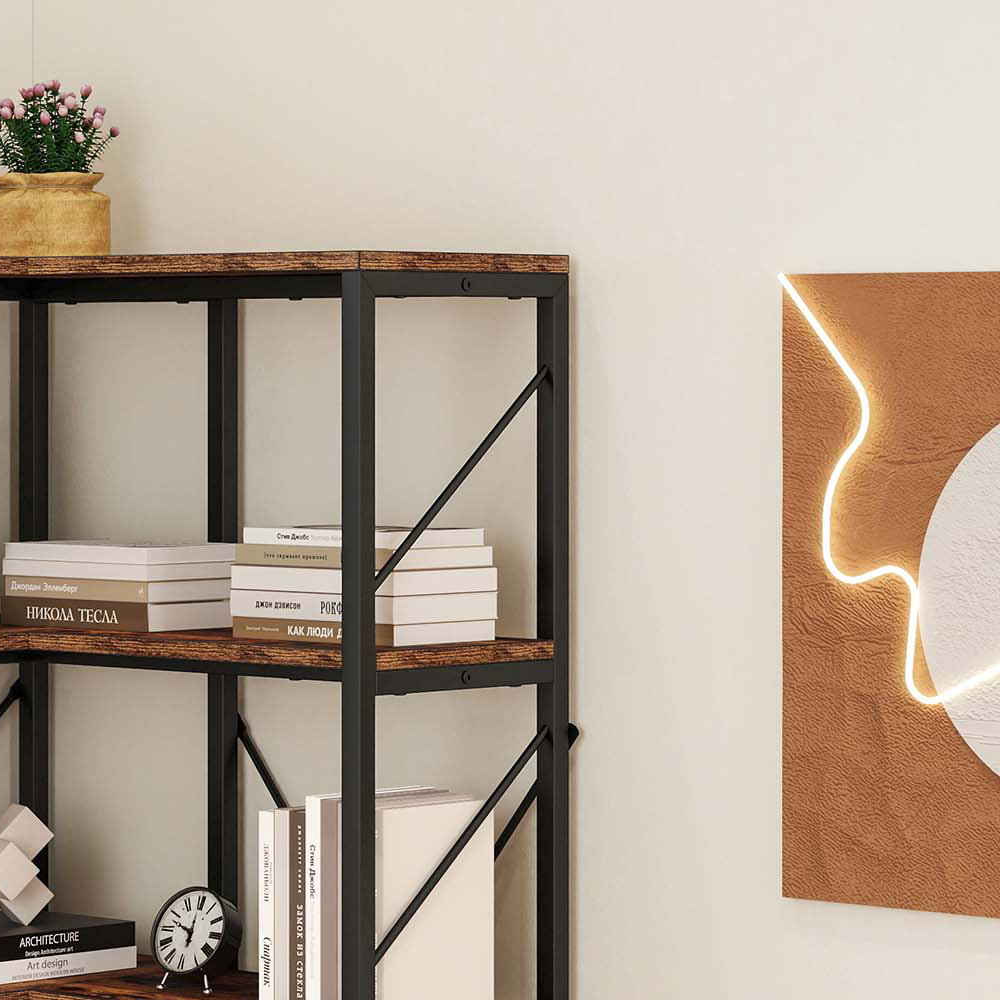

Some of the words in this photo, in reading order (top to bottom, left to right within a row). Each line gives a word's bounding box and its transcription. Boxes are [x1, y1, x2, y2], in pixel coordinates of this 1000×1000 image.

[290, 533, 310, 541] Джобс
[10, 580, 41, 592] Джордан
[274, 602, 301, 610] ДЭВИСОН
[26, 606, 74, 621] НИКОЛА
[78, 608, 119, 624] ТЕСЛА
[287, 625, 305, 636] КАК
[306, 626, 334, 639] ЛЮДИ
[19, 931, 80, 948] ARCHITECTURE
[41, 947, 66, 955] Architecture
[296, 943, 303, 957] из
[26, 961, 40, 970] Art
[41, 958, 68, 969] design
[260, 936, 272, 987] Спартак
